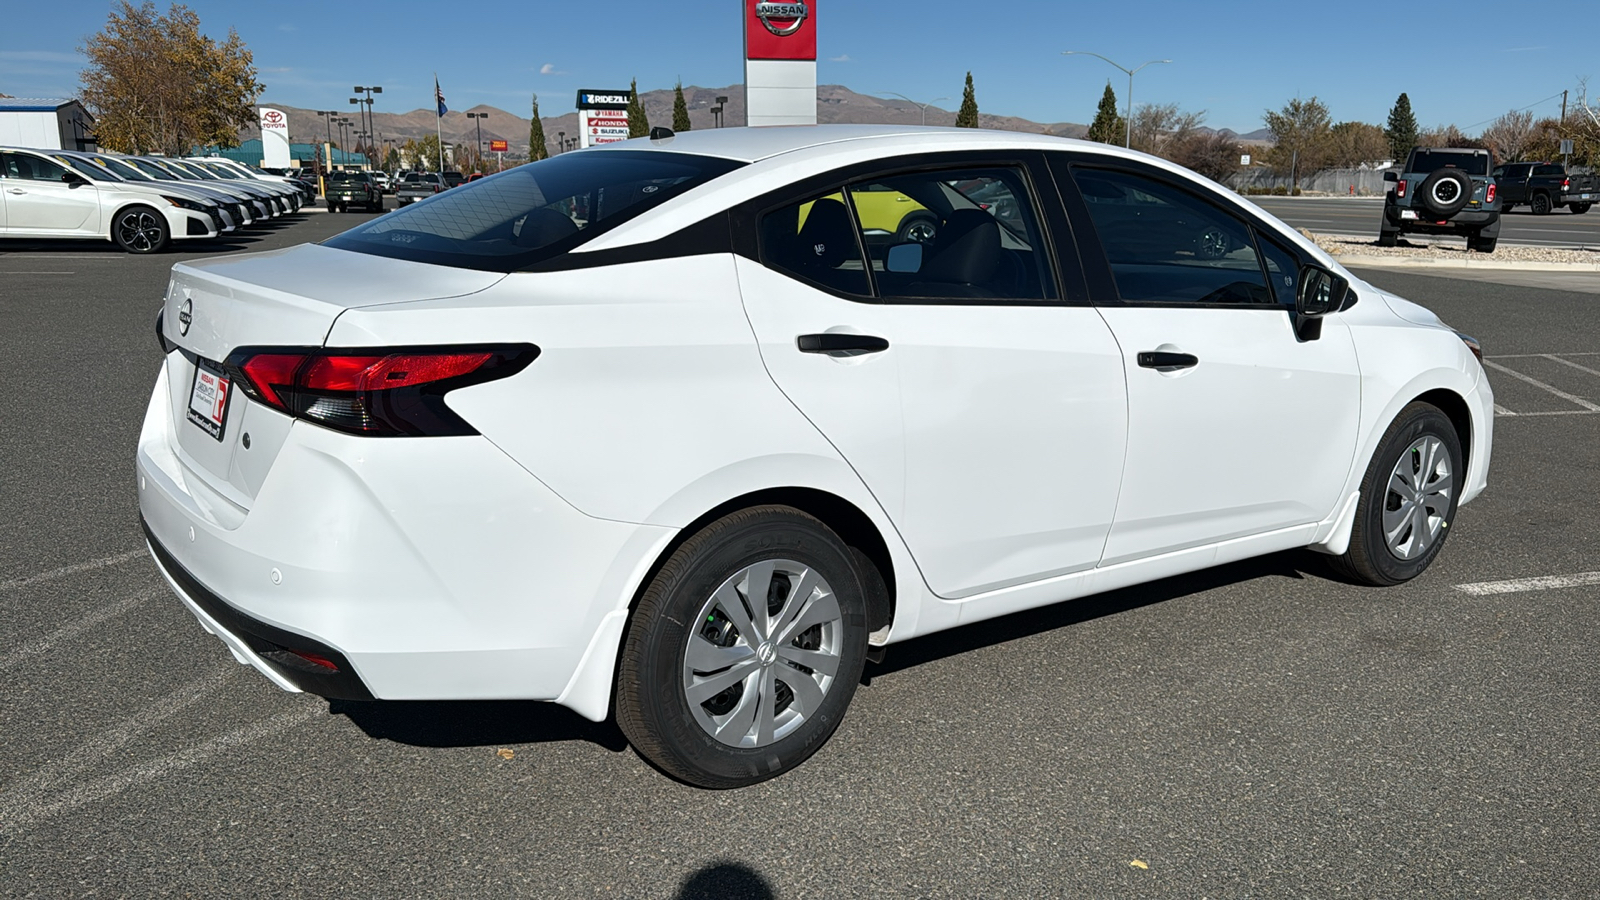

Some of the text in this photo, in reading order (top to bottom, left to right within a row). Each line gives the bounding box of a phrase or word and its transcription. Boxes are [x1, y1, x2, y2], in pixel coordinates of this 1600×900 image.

[761, 5, 804, 14] NISSAN
[594, 94, 632, 104] RIDEZILL
[201, 372, 214, 386] NISSAN
